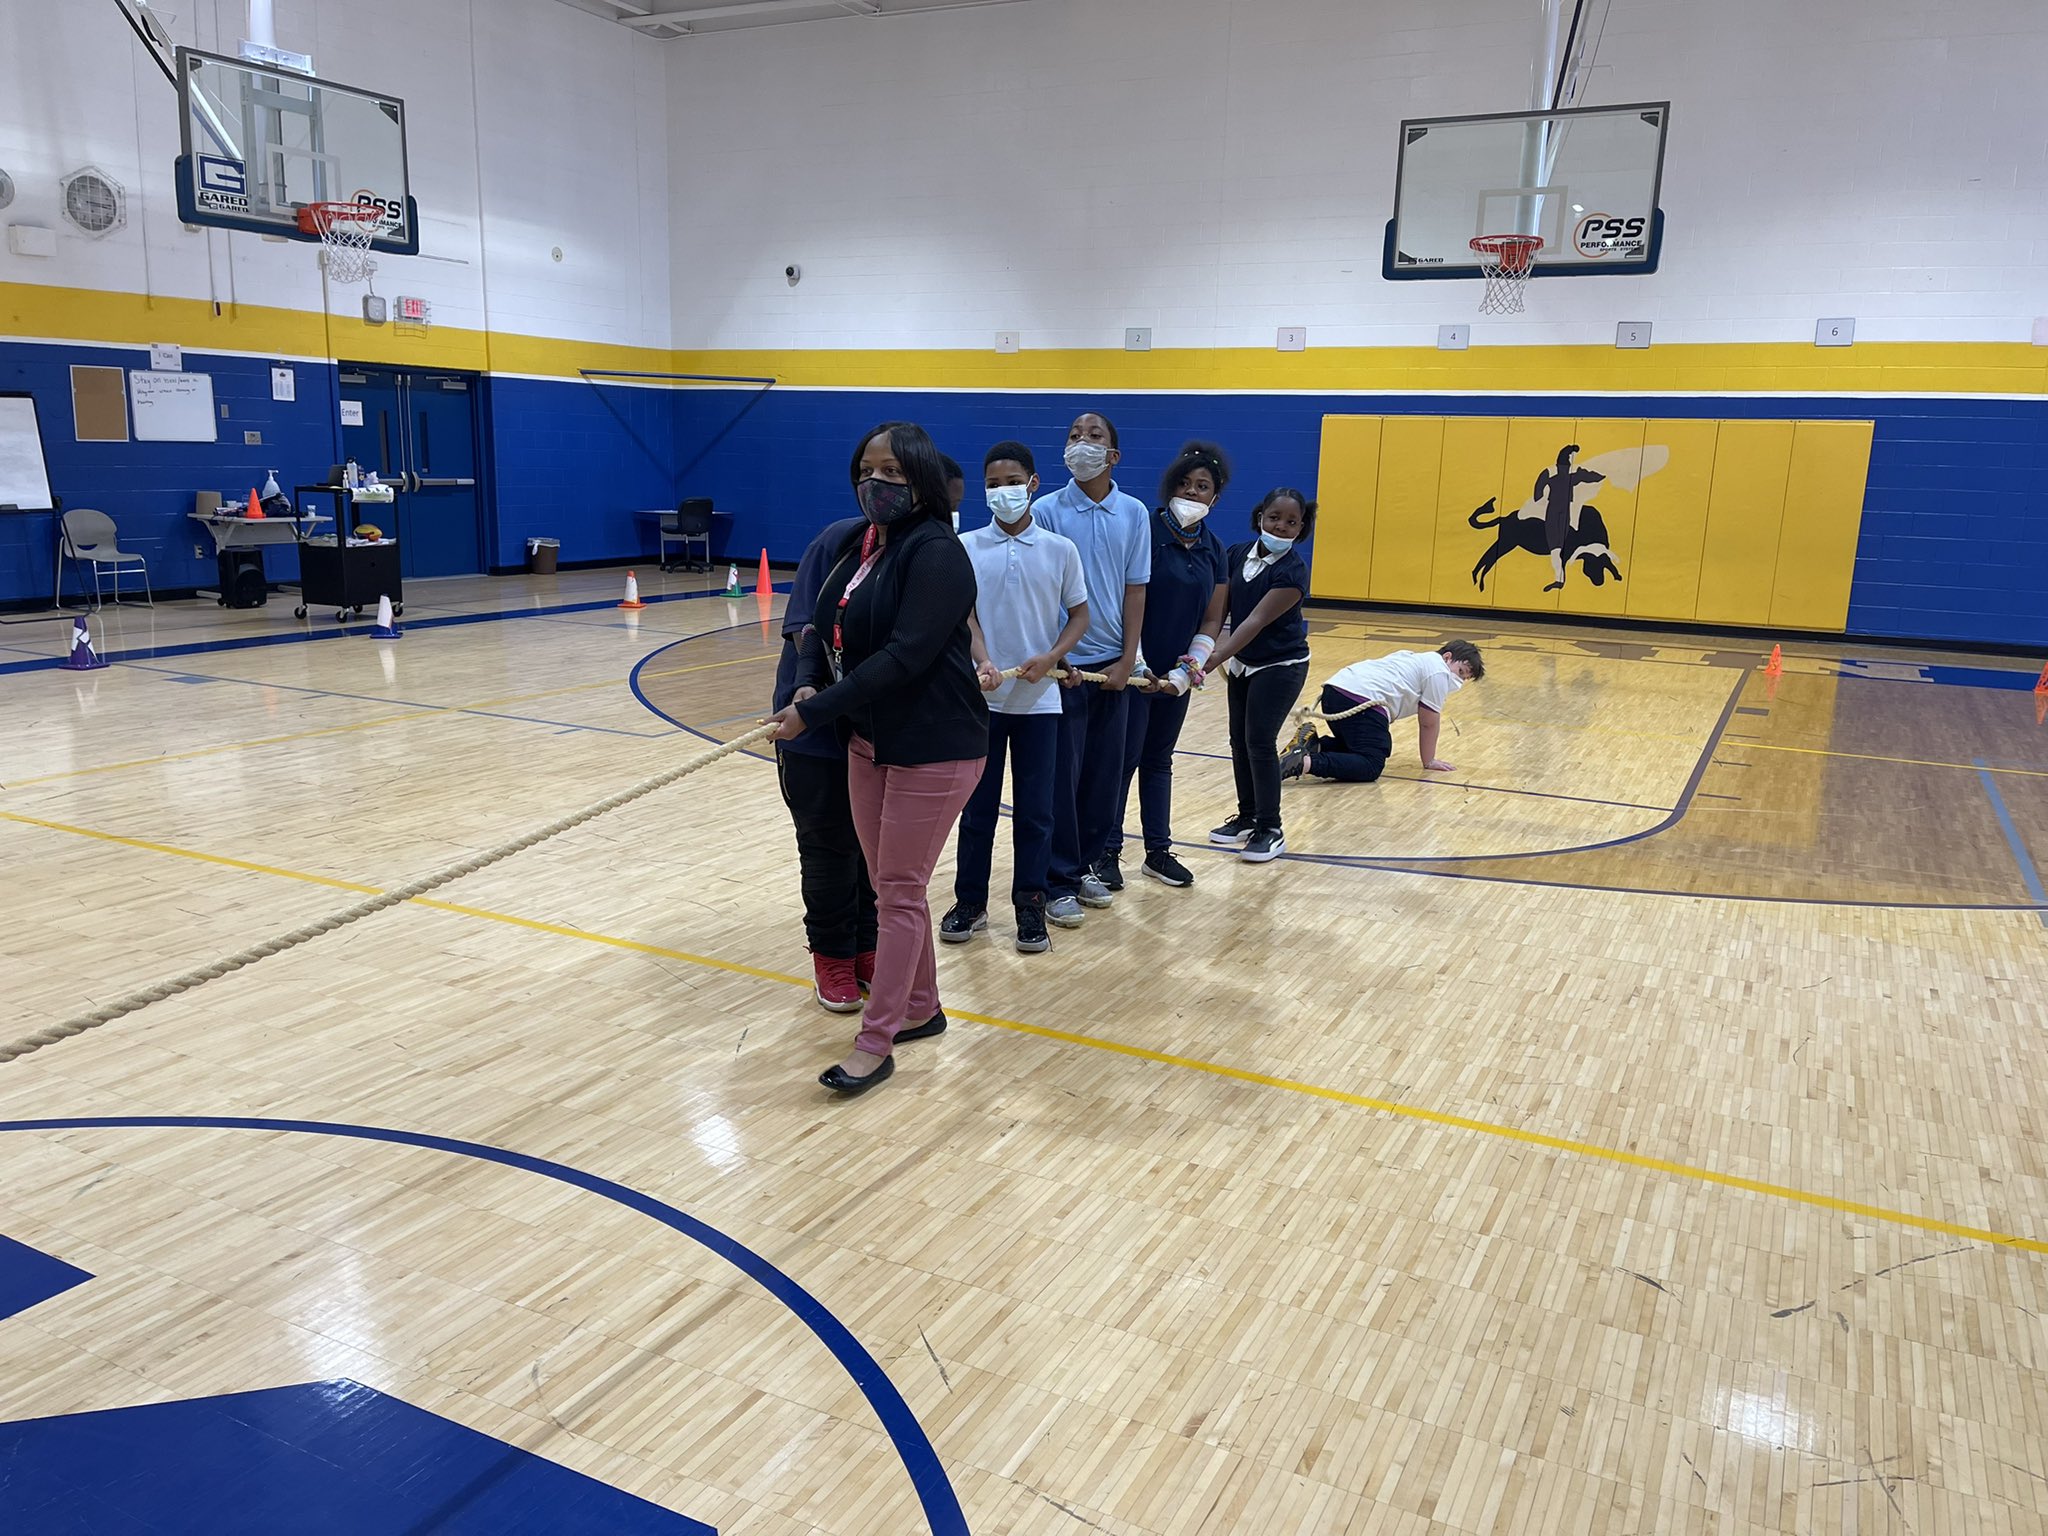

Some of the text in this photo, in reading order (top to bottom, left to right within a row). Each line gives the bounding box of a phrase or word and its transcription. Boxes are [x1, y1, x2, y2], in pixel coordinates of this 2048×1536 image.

[200, 192, 248, 206] GARED
[219, 203, 249, 212] GARED
[1581, 217, 1646, 239] PSS
[1580, 239, 1643, 248] PERFOMANCE
[405, 298, 424, 317] EXIT
[1831, 326, 1839, 336] 6
[1005, 336, 1009, 344] 1
[1136, 334, 1141, 342] 2
[1289, 334, 1294, 342] 3
[1450, 332, 1456, 340] 4
[1630, 332, 1636, 341] 5
[133, 374, 152, 389] Stay
[341, 408, 360, 418] Enter
